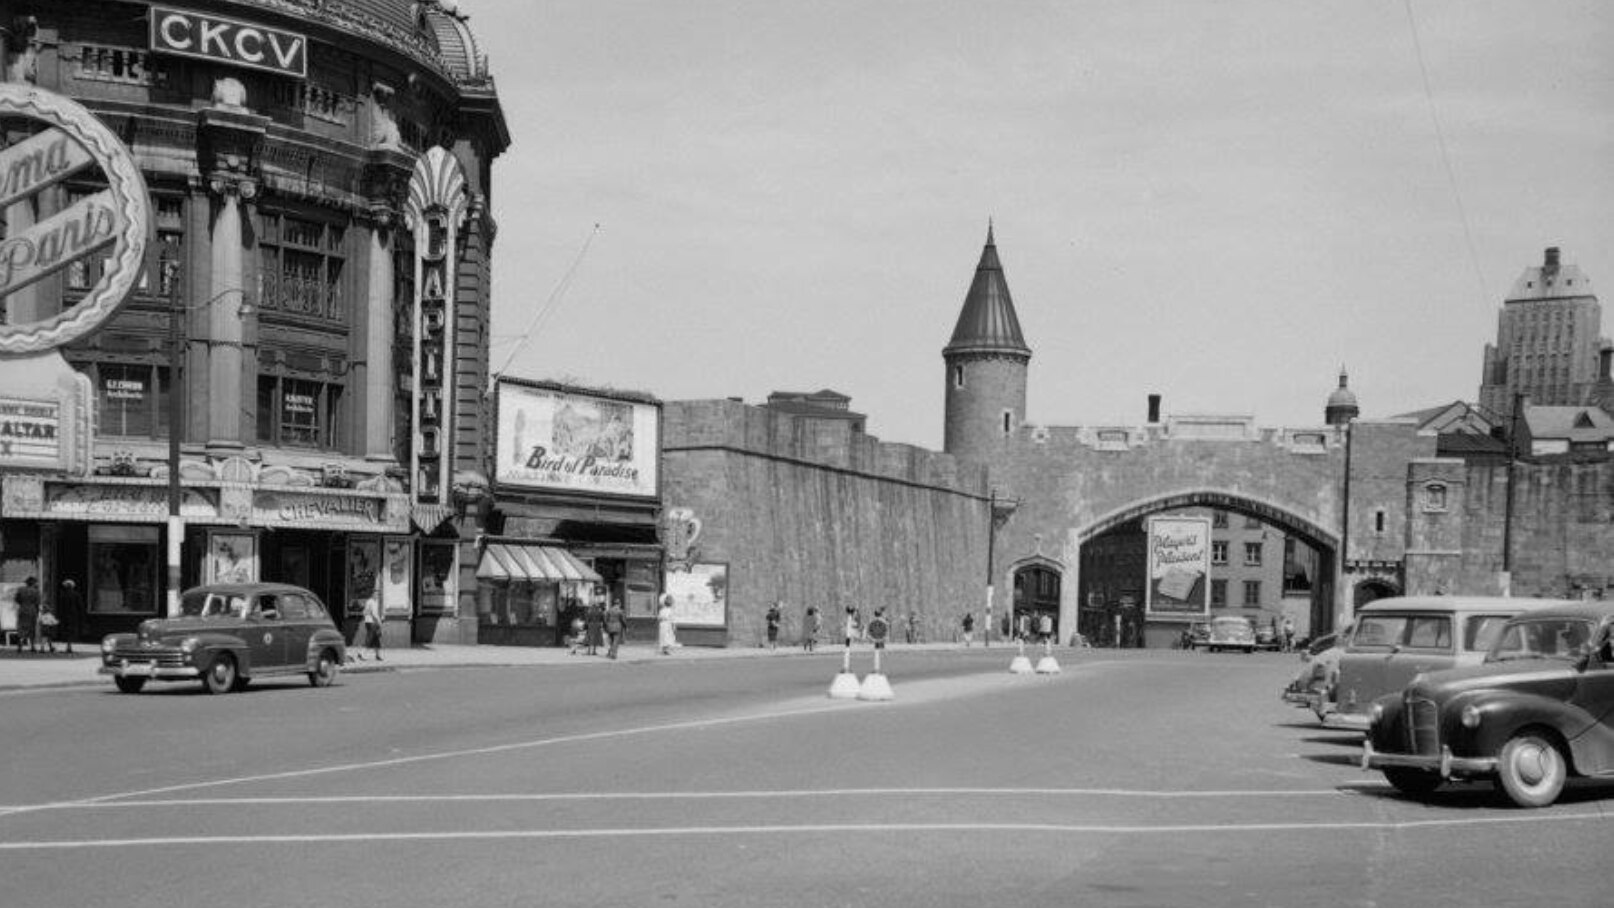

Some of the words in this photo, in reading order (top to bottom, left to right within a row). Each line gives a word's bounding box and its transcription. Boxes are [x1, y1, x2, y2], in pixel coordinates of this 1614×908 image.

[160, 14, 302, 69] CKCV
[0, 202, 116, 286] Paris
[418, 210, 447, 498] CAPITOL
[0, 421, 55, 438] ALTAR
[525, 446, 566, 473] Bird
[564, 456, 581, 475] of
[578, 455, 639, 480] Paradise
[279, 497, 379, 523] CHEVALIER
